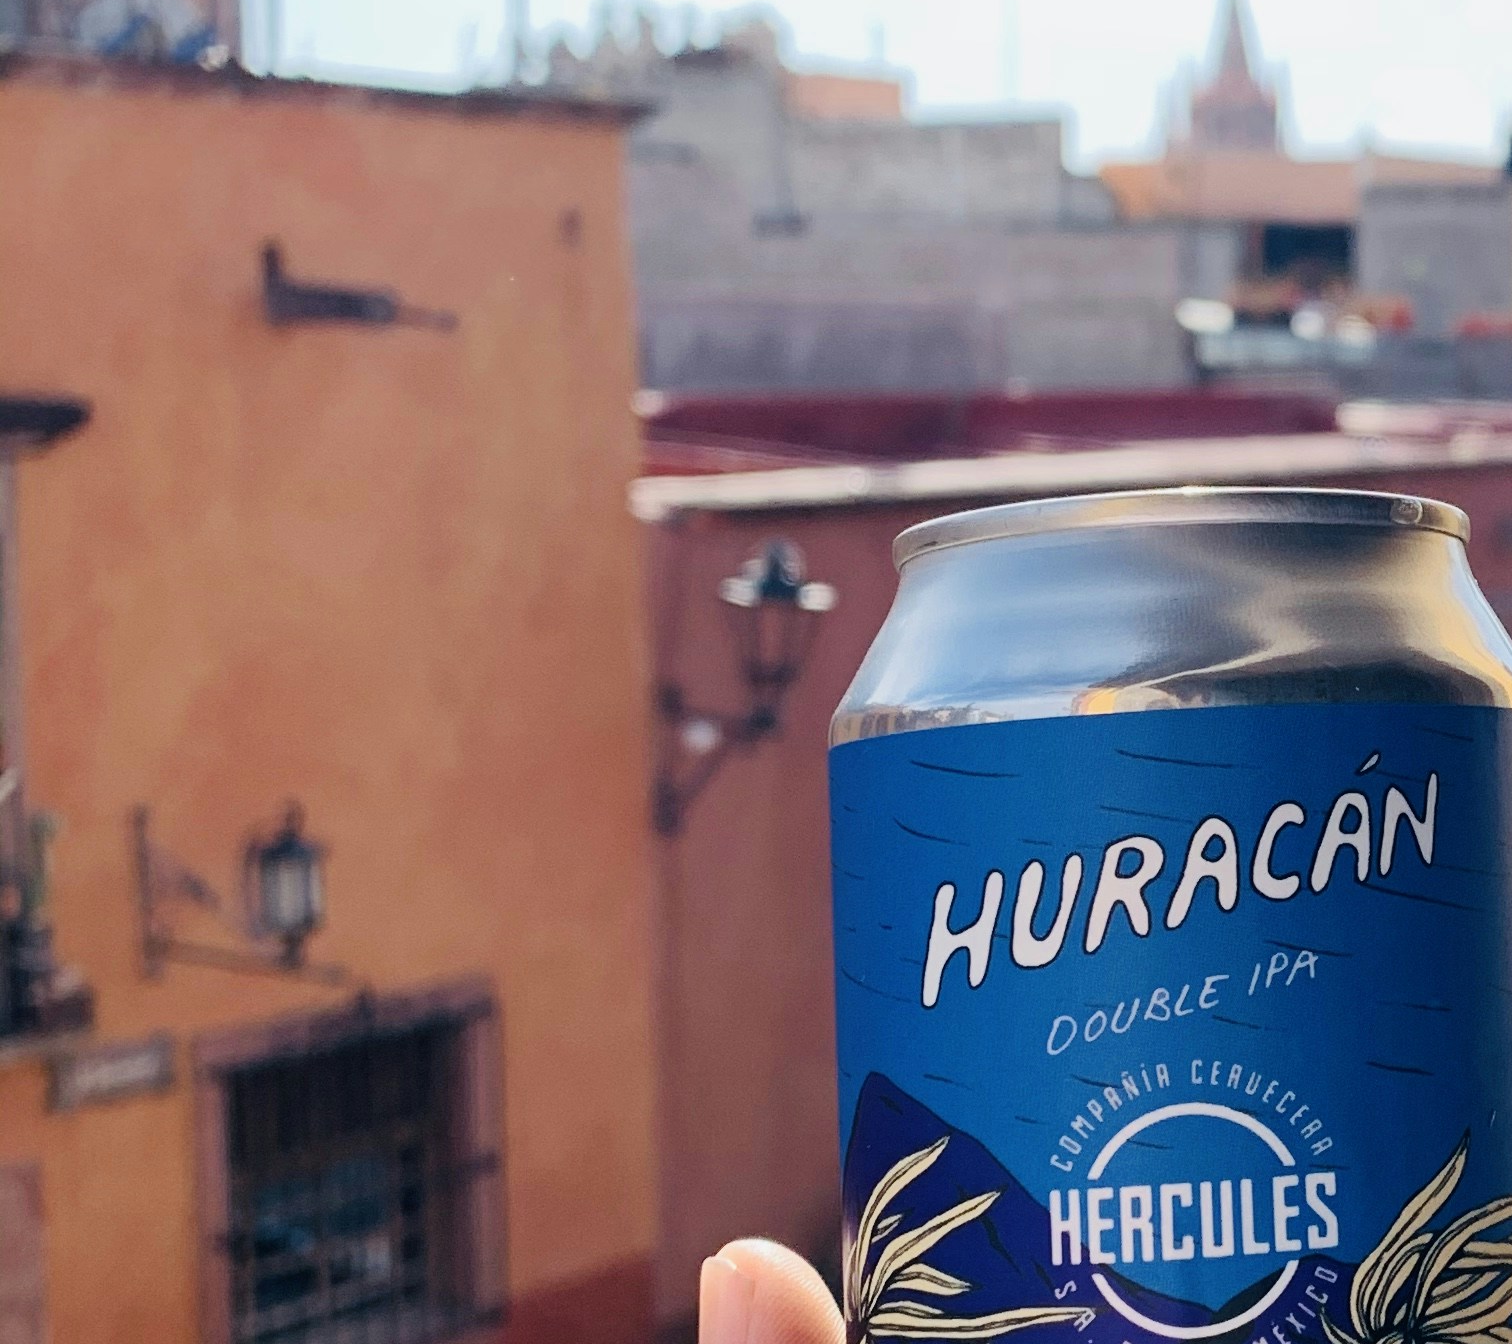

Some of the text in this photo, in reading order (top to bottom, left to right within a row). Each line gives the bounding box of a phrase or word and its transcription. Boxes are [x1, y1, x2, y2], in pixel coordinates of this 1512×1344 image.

[922, 753, 1440, 1008] HURACÁN
[1046, 950, 1319, 1056] DOUBLE IPA
[1048, 1171, 1340, 1267] HERCULES
